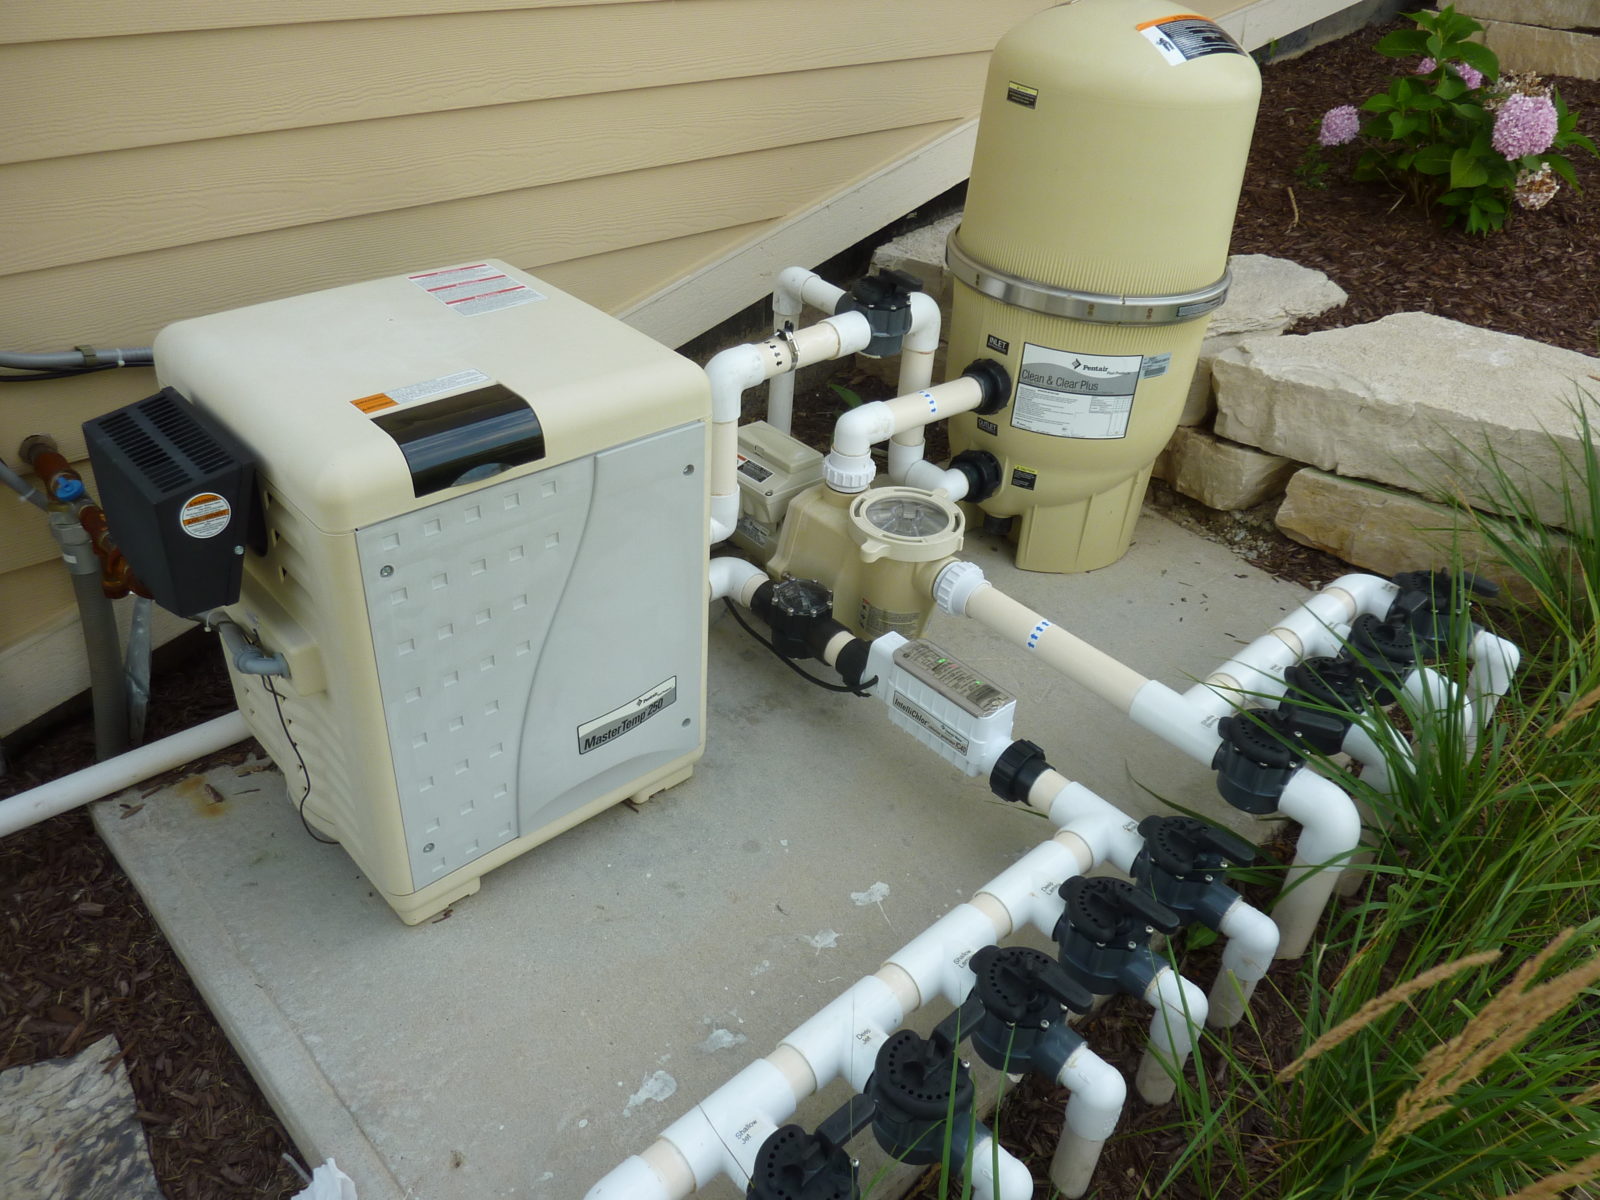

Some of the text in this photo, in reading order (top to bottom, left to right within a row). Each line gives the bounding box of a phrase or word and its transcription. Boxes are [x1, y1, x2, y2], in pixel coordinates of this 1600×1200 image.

[989, 337, 1007, 349] INLET
[1082, 364, 1109, 373] Pentair
[1021, 369, 1099, 391] Clean & Clear Plus
[979, 420, 997, 432] OUTLET
[894, 698, 928, 726] IntelliChlor
[584, 698, 664, 750] MasterTemp 250
[856, 1028, 871, 1040] Deep
[862, 1035, 872, 1045] Jet
[735, 1120, 757, 1140] Shallow
[742, 1133, 751, 1145] Jet
